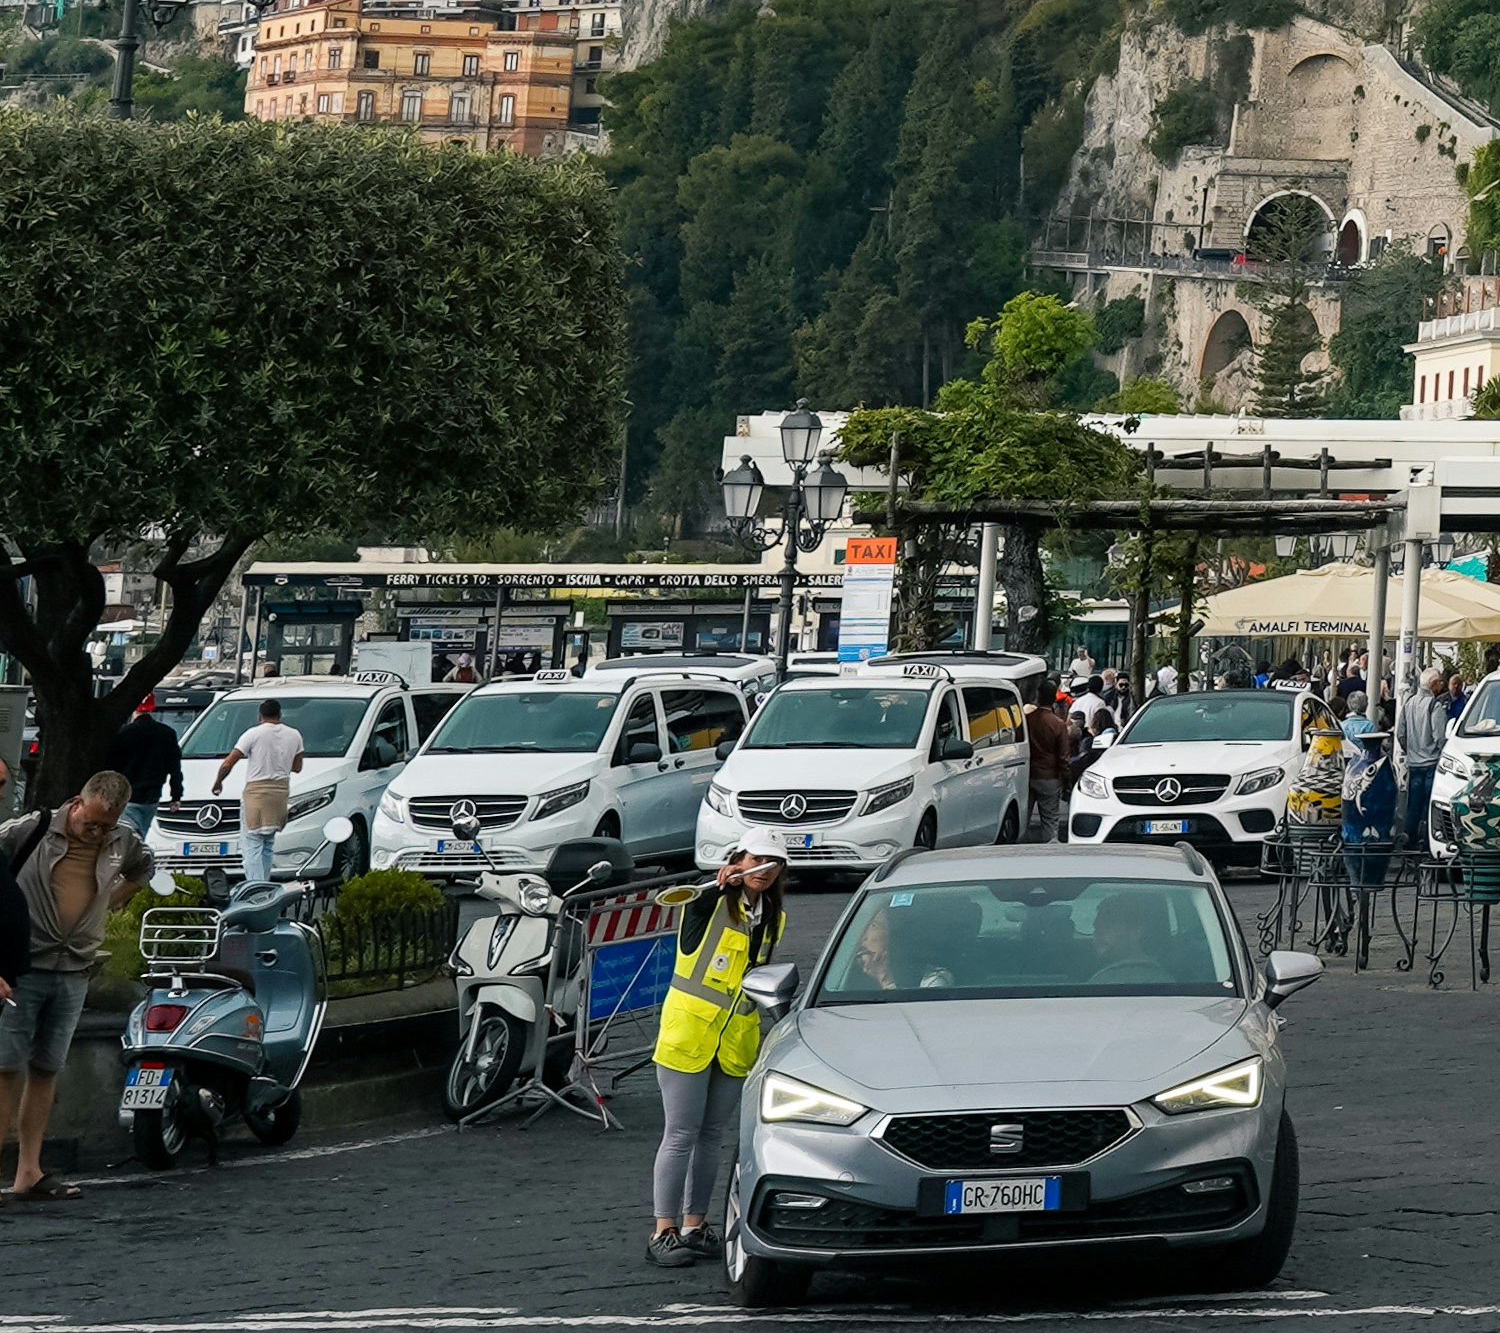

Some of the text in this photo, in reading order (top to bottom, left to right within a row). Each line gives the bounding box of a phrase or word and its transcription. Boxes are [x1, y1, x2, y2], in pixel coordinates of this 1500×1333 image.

[850, 543, 892, 560] TAXI
[386, 574, 420, 585] FERRY
[425, 574, 469, 585] TICKETS
[473, 574, 491, 586] TO:
[496, 574, 555, 585] SORRENTO
[565, 574, 602, 586] ISCHIA
[614, 574, 646, 586] CAPRI
[659, 574, 700, 586] GROTTA
[703, 574, 737, 586] DELLO
[1248, 620, 1370, 633] AMALFI TERMINAL
[536, 670, 567, 681] TAXI
[903, 665, 937, 677] TAXI
[357, 672, 390, 683] TAXI
[138, 1070, 156, 1085] FD
[123, 1087, 166, 1106] 81314
